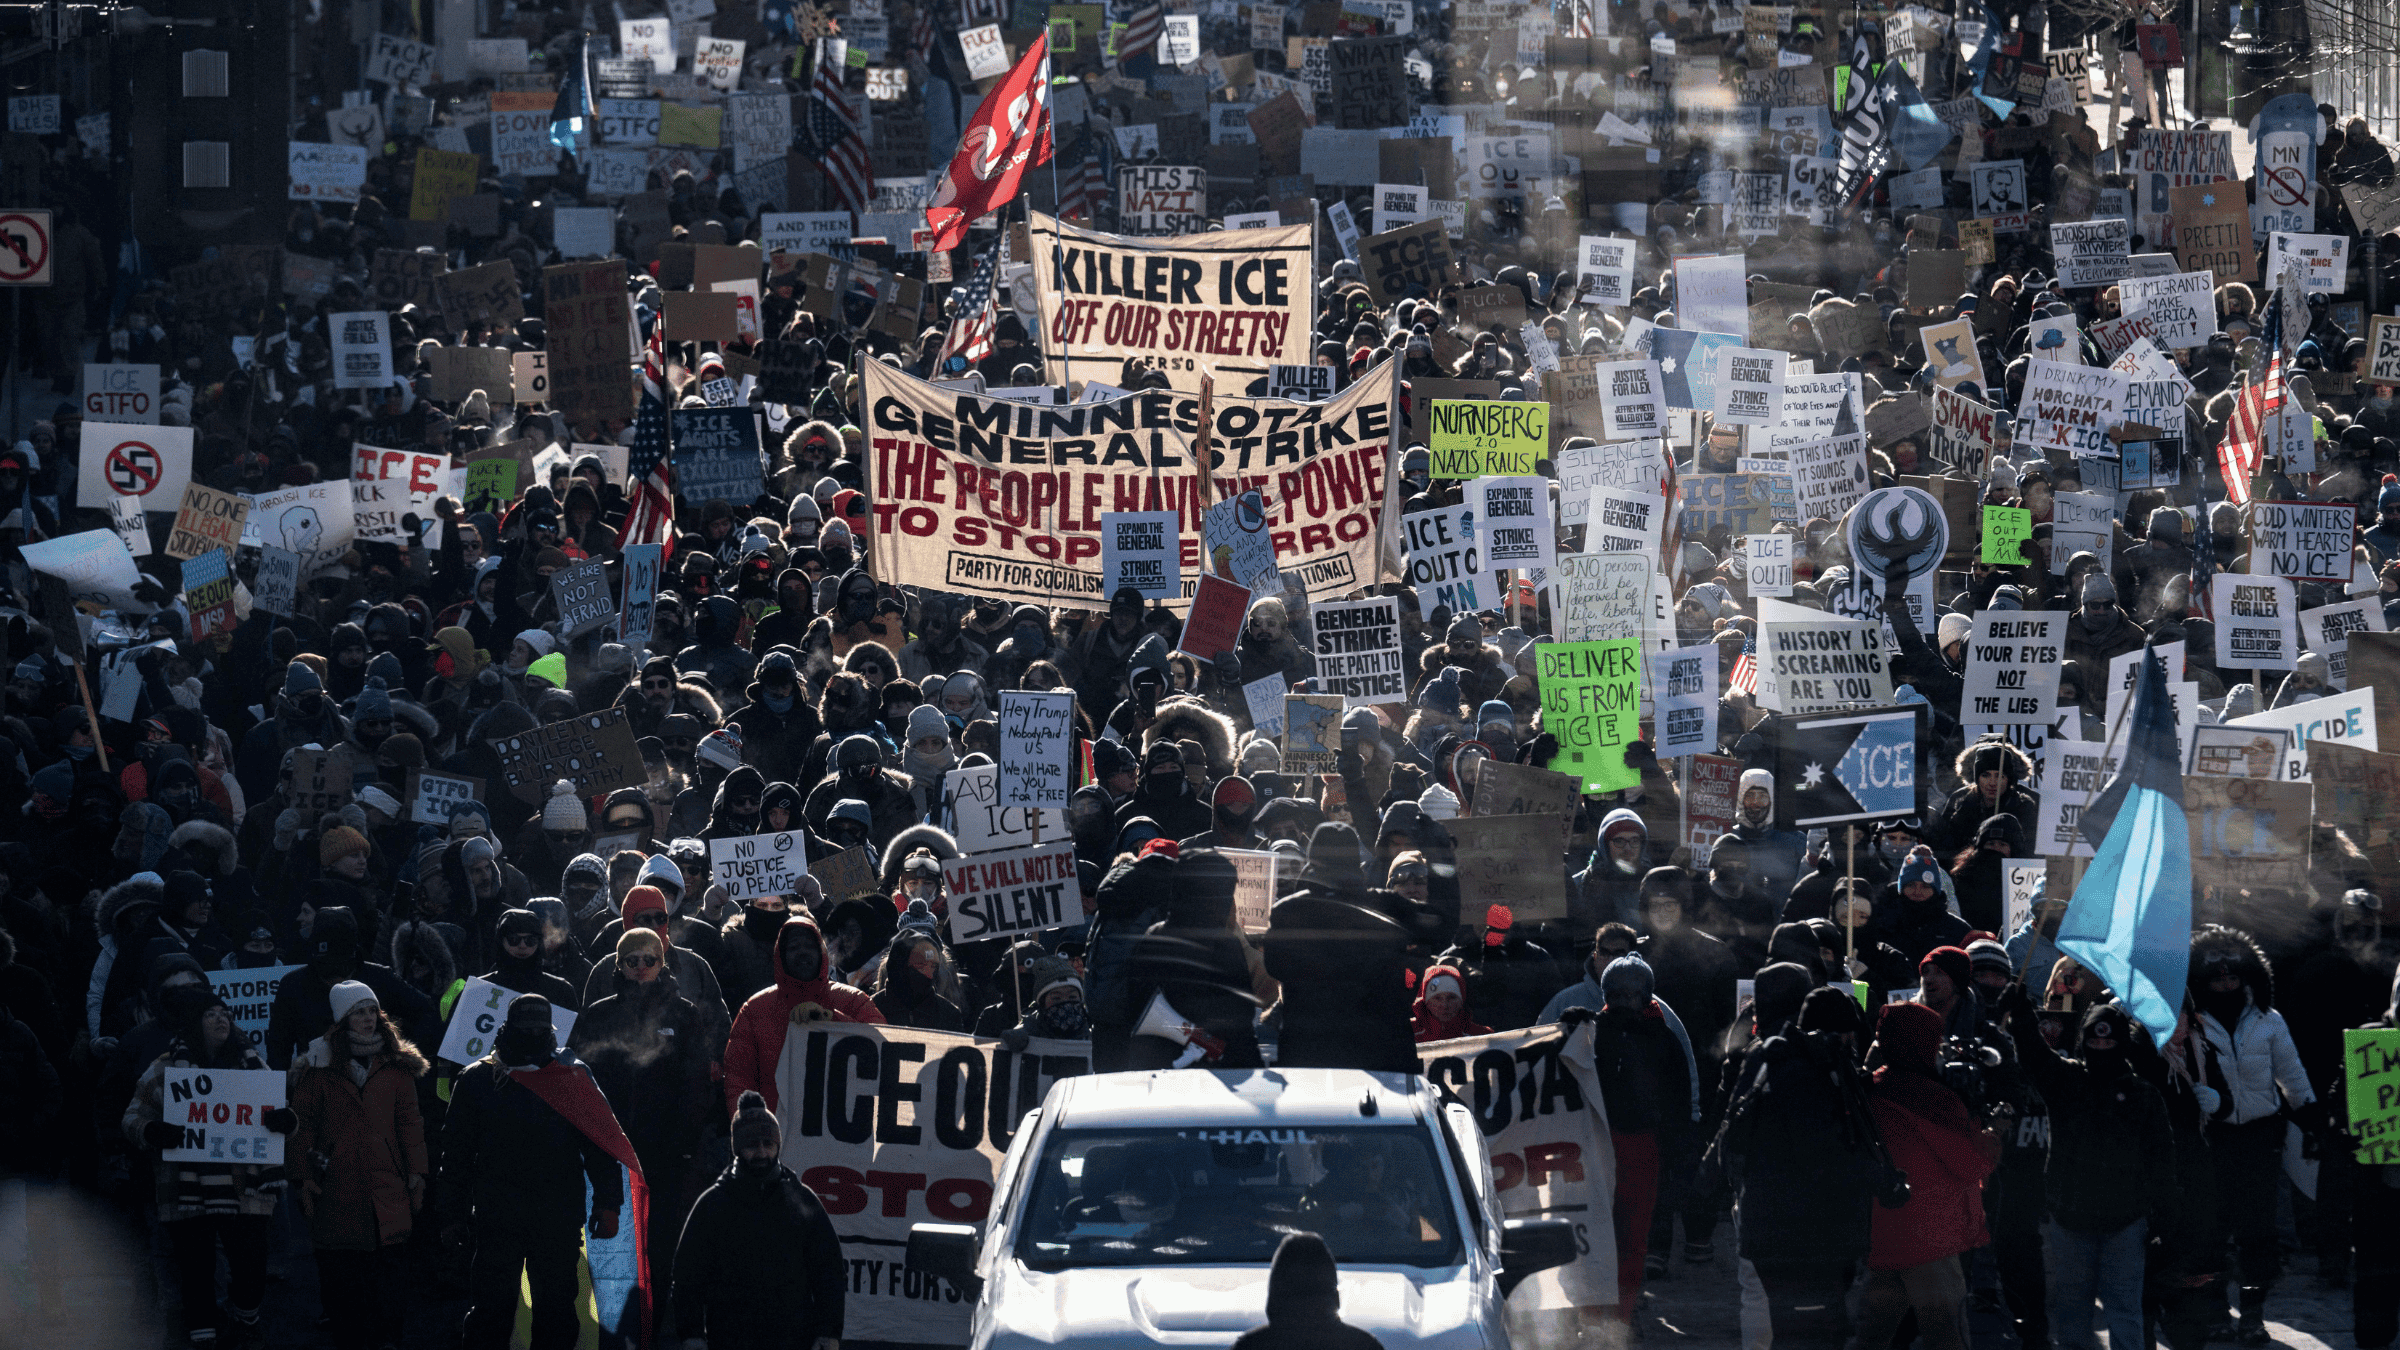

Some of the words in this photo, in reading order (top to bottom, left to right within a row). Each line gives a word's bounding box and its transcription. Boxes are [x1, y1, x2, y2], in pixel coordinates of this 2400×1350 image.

[631, 25, 654, 38] NO
[1886, 17, 1902, 33] MN
[962, 27, 998, 48] FUCK
[710, 43, 733, 56] NO
[1334, 43, 1401, 68] WHAT
[383, 64, 420, 82] ICE
[706, 66, 728, 80] NO
[2046, 52, 2087, 77] FUCK
[867, 69, 900, 84] ICE
[865, 85, 901, 100] OUT
[1342, 103, 1405, 127] FUCK
[1484, 139, 1530, 159] ICE
[2140, 132, 2172, 150] MAKE
[2176, 133, 2228, 151] AMERICA
[2144, 151, 2187, 172] GREAT
[2273, 147, 2300, 163] MN
[1123, 168, 1182, 189] THIS
[1189, 166, 1206, 189] IS
[1480, 164, 1541, 190] OUT
[1126, 192, 1195, 213] NAZI
[1384, 192, 1403, 202] EXPAND
[1406, 193, 1417, 202] THE
[1384, 201, 1417, 213] GENERAL
[776, 220, 804, 233] AND
[811, 220, 848, 232] THEN
[2184, 223, 2241, 249] PRETTI
[1369, 231, 1441, 278] ICE
[1590, 245, 1611, 255] EXPAND
[1612, 245, 1624, 255] THE
[1590, 254, 1623, 268] GENERAL
[2300, 248, 2318, 256] FIGHT
[1052, 243, 1203, 305] KILLER
[1218, 259, 1289, 307] ICE
[2188, 251, 2241, 277] GOOD
[1383, 263, 1451, 296] OUT
[1591, 274, 1619, 287] STRIKE!
[2121, 276, 2210, 300] IMMIGRANTS
[2147, 296, 2183, 311] MAKE
[1053, 301, 1103, 345] OFF
[1105, 301, 1159, 346] OUR
[1168, 310, 1289, 358] STREETS!
[102, 369, 140, 391] ICE
[705, 380, 729, 391] ICE
[1276, 365, 1329, 387] KILLER
[2045, 369, 2085, 383] DRINK
[86, 392, 150, 415] GTFO
[2033, 387, 2113, 412] HORCHATA
[696, 415, 731, 431] ICE
[955, 395, 1322, 439] MINNESOTA
[1936, 390, 1993, 443] SHAME
[2038, 403, 2098, 427] WARM
[679, 430, 740, 447] AGENTS
[873, 395, 1182, 468] GENERAL
[1955, 430, 1970, 442] ON
[695, 448, 727, 462] ARE
[1433, 449, 1479, 474] NAZIS
[470, 462, 502, 477] FUCK
[872, 438, 947, 504] THE
[954, 461, 1103, 531] PEOPLE
[1486, 488, 1517, 500] EXPAND
[1519, 487, 1534, 499] THE
[1682, 475, 1748, 506] ICE
[186, 489, 211, 511] NO
[213, 498, 246, 523] ONE
[260, 490, 299, 512] ABOLISH
[1487, 500, 1534, 518] GENERAL
[1603, 511, 1648, 532] GENERAL
[1990, 509, 2021, 522] ICE
[2252, 506, 2286, 529] COLD
[2292, 508, 2352, 530] WINTERS
[872, 504, 939, 537] TO
[952, 516, 1102, 565] STOP
[1117, 522, 1148, 535] EXPAND
[1149, 522, 1164, 535] THE
[1407, 514, 1453, 550] ICE
[1493, 529, 1534, 546] STRIKE!
[1993, 526, 2018, 535] OUT
[1117, 535, 1164, 550] GENERAL
[1754, 539, 1784, 558] ICE
[2252, 531, 2286, 551] WARM
[2297, 531, 2350, 553] HEARTS
[557, 573, 576, 588] WE
[578, 564, 601, 580] ARE
[1121, 560, 1162, 576] STRIKE!
[2271, 553, 2299, 576] NO
[2307, 554, 2338, 577] ICE
[635, 562, 647, 592] DO
[187, 588, 206, 614] ICE
[207, 578, 230, 604] OUT
[563, 581, 598, 605] NOT
[2233, 585, 2276, 602] JUSTICE
[563, 596, 612, 627] AFRAID
[1315, 606, 1396, 630] GENERAL
[2231, 602, 2252, 617] FOR
[2253, 602, 2279, 618] ALEX
[2322, 609, 2365, 630] JUSTICE
[1777, 630, 1851, 651] HISTORY
[1861, 628, 1878, 649] IS
[1988, 621, 2048, 638] BELIEVE
[1317, 630, 1398, 654] STRIKE:
[1318, 658, 1344, 677] THE
[1350, 653, 1380, 675] PATH
[1383, 651, 1400, 670] TO
[1544, 647, 1637, 678] DELIVER
[1778, 653, 1881, 675] SCREAMING
[1975, 646, 2012, 662] YOUR
[2020, 646, 2057, 663] EYES
[1321, 675, 1403, 698] JUSTICE
[1790, 681, 1824, 700] ARE
[1836, 678, 1871, 699] YOU
[1996, 670, 2026, 688] NOT
[1547, 687, 1569, 713] US
[1578, 682, 1635, 714] FROM
[1974, 697, 1999, 714] THE
[2008, 698, 2038, 714] LIES
[577, 709, 626, 733] YOUR
[1560, 713, 1621, 748] ICE
[503, 734, 596, 772] PRIVILEGE
[1284, 752, 1337, 763] MINNESOTA
[507, 763, 558, 788] BLUR
[558, 751, 608, 775] YOUR
[1284, 761, 1337, 774] STRONG
[1694, 762, 1719, 780] SALT
[1720, 762, 1738, 780] THE
[1858, 742, 1914, 789] ICE
[421, 776, 469, 796] GTFO
[1037, 790, 1064, 801] FREE
[734, 841, 755, 859] NO
[719, 856, 785, 879] JUSTICE
[945, 866, 980, 895] WE
[981, 857, 1023, 890] WILL
[1024, 855, 1053, 883] NOT
[1056, 852, 1075, 879] BE
[747, 873, 795, 895] PEACE
[958, 883, 1065, 939] SILENT
[170, 1074, 213, 1103] NO
[801, 1030, 926, 1146] ICE
[210, 1137, 268, 1159] ICE
